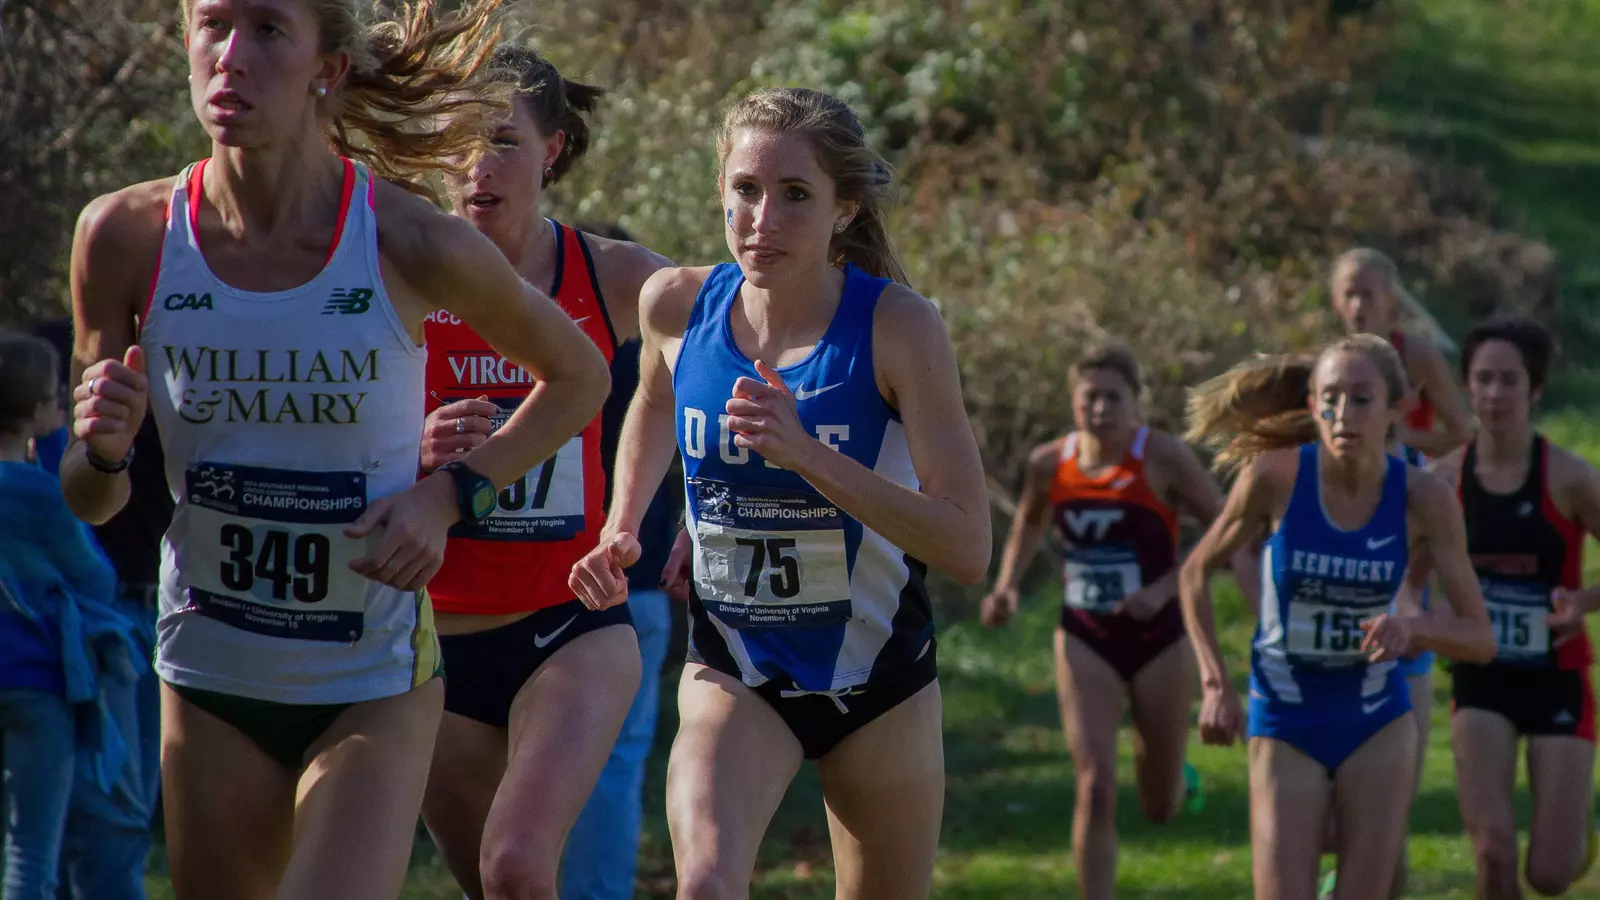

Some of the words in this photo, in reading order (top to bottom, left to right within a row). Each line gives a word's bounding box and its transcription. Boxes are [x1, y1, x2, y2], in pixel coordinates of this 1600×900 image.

[164, 293, 213, 311] CAA
[162, 345, 380, 383] WILLIAM
[447, 356, 533, 384] VIRGI
[179, 388, 369, 424] &MARY
[243, 493, 362, 510] CHAMPIONSHIPS
[738, 507, 837, 519] CHAMPIONSHIPS
[494, 519, 530, 528] University
[540, 519, 566, 527] Virginia
[1063, 509, 1125, 540] VT
[220, 523, 330, 603] 349
[735, 537, 800, 598] 75
[1292, 550, 1395, 581] KENTUCKY
[209, 595, 241, 609] Division
[252, 604, 292, 620] University
[305, 614, 338, 623] Virginia
[245, 613, 285, 627] November
[288, 621, 298, 629] 15
[749, 614, 785, 622] November
[754, 607, 790, 616] University
[792, 606, 800, 614] of
[801, 604, 829, 615] Virginia
[1489, 610, 1529, 646] 15
